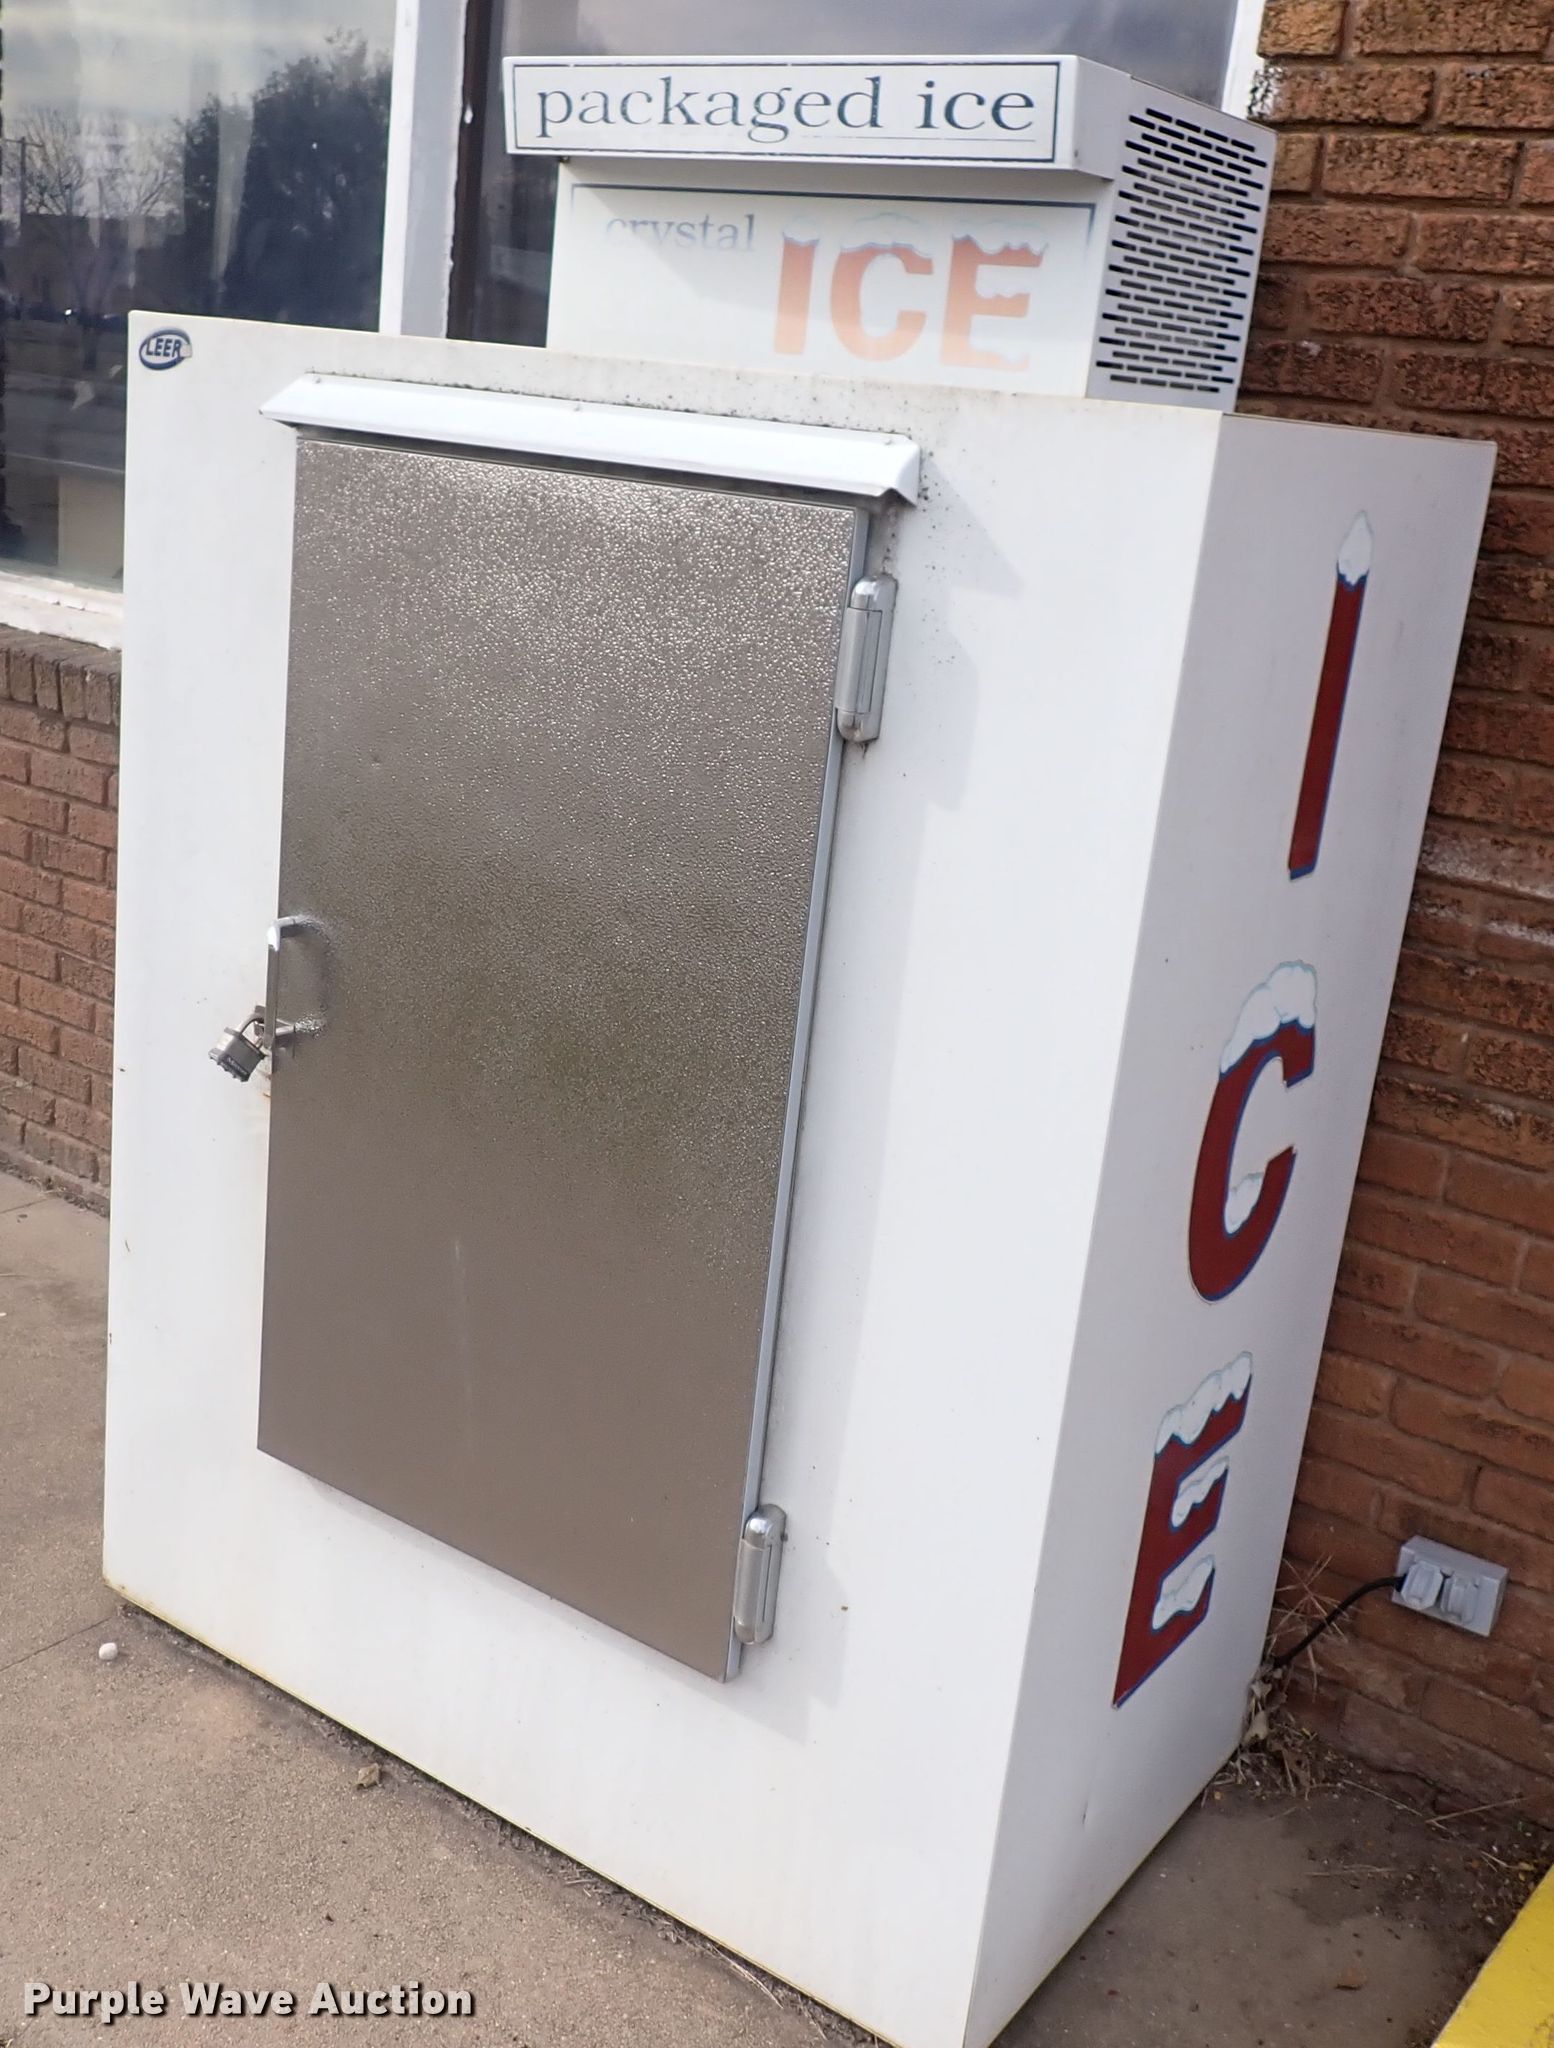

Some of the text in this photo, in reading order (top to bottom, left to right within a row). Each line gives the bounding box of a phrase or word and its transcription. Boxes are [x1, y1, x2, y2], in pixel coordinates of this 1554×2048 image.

[536, 76, 1036, 143] packaged ice
[145, 337, 182, 358] LEER
[773, 213, 1050, 372] ICE
[1114, 511, 1374, 1709] ICE
